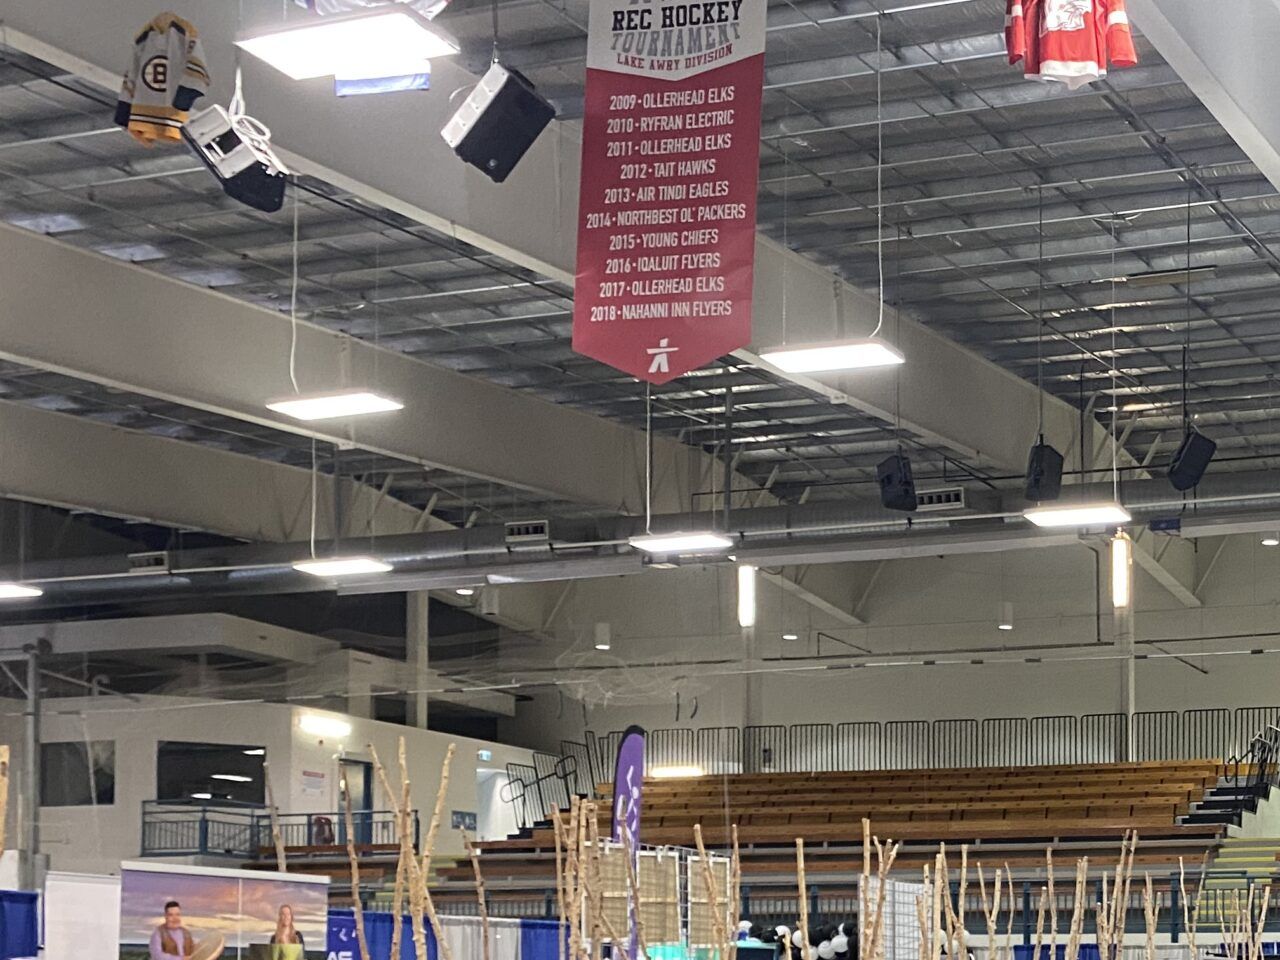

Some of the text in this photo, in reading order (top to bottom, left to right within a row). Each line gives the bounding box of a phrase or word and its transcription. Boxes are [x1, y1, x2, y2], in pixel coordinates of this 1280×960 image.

[611, 0, 743, 31] REC HOCKEY
[610, 22, 741, 57] TOURNAMENT
[617, 43, 733, 71] LAKE AWRY DIVISION
[609, 86, 735, 110] 2009 OLLERHEAD ELKS
[606, 109, 735, 133] 2010 RYFRAN ELECTRIC
[606, 134, 732, 157] 2011 OLLERHEAD ELKS
[620, 159, 716, 179] 2012 TAIT HAWKS
[604, 181, 729, 204] 2013 AIR TINDI EAGLES
[586, 214, 611, 229] 2014
[617, 209, 678, 226] NORTHBEST
[698, 204, 747, 221] PACKERS
[609, 228, 719, 250] 2015 YOUNG CHIEFS
[605, 252, 721, 274] 2016 IQALUIT FLYERS
[600, 276, 725, 297] 2017 OLLERHEAD ELKS
[591, 300, 732, 322] 2018 NAHANNI INN FLYERS
